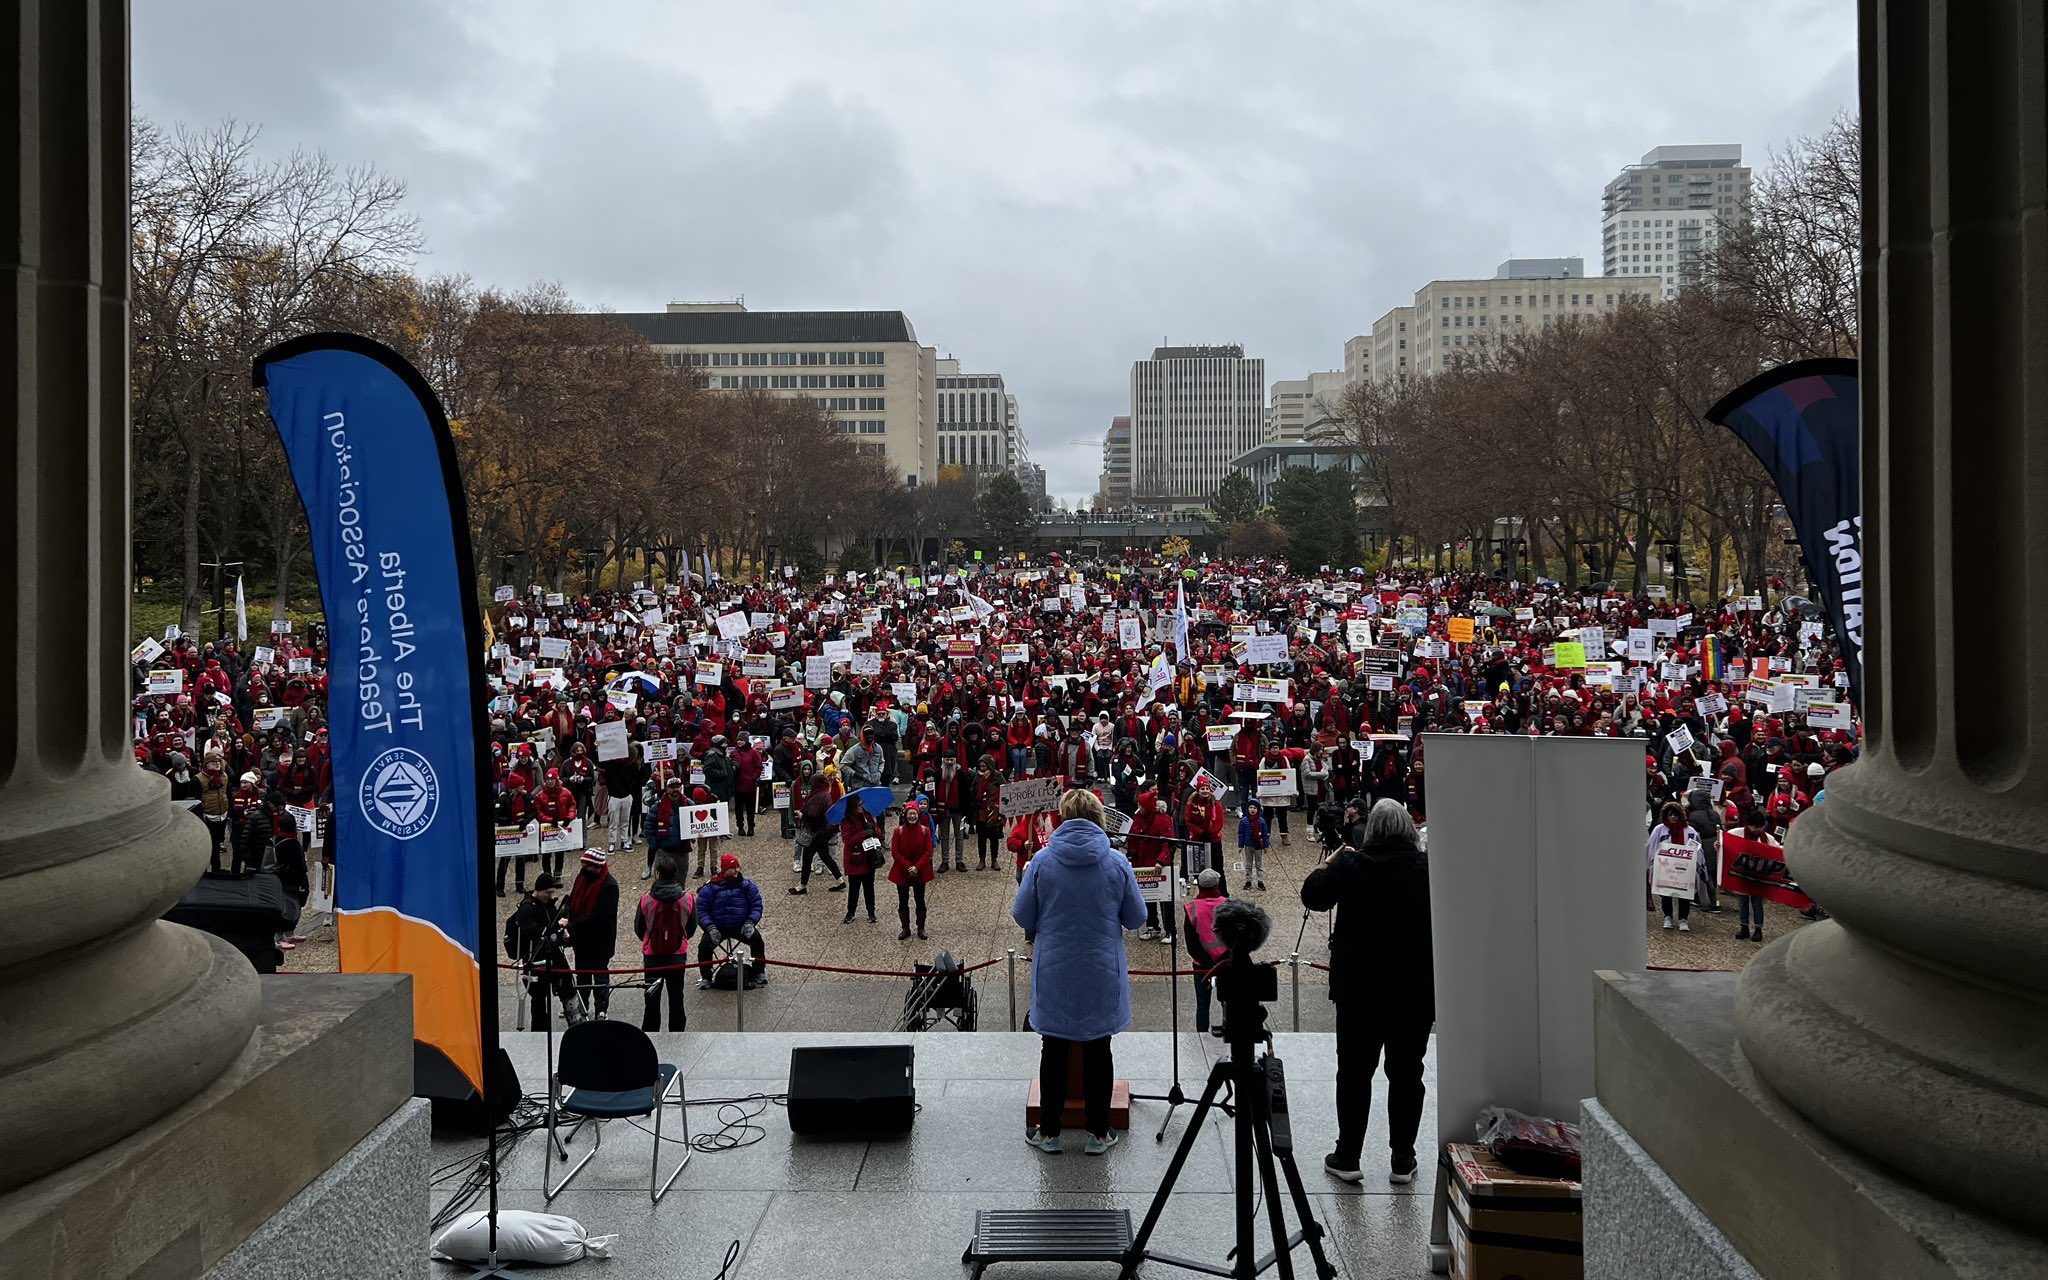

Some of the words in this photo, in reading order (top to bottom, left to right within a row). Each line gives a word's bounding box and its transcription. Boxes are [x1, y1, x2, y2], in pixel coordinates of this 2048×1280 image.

[1009, 787, 1055, 802] PROBLEMS
[690, 810, 693, 823] I
[690, 821, 717, 830] PUBLIC
[1668, 847, 1694, 858] CUPE
